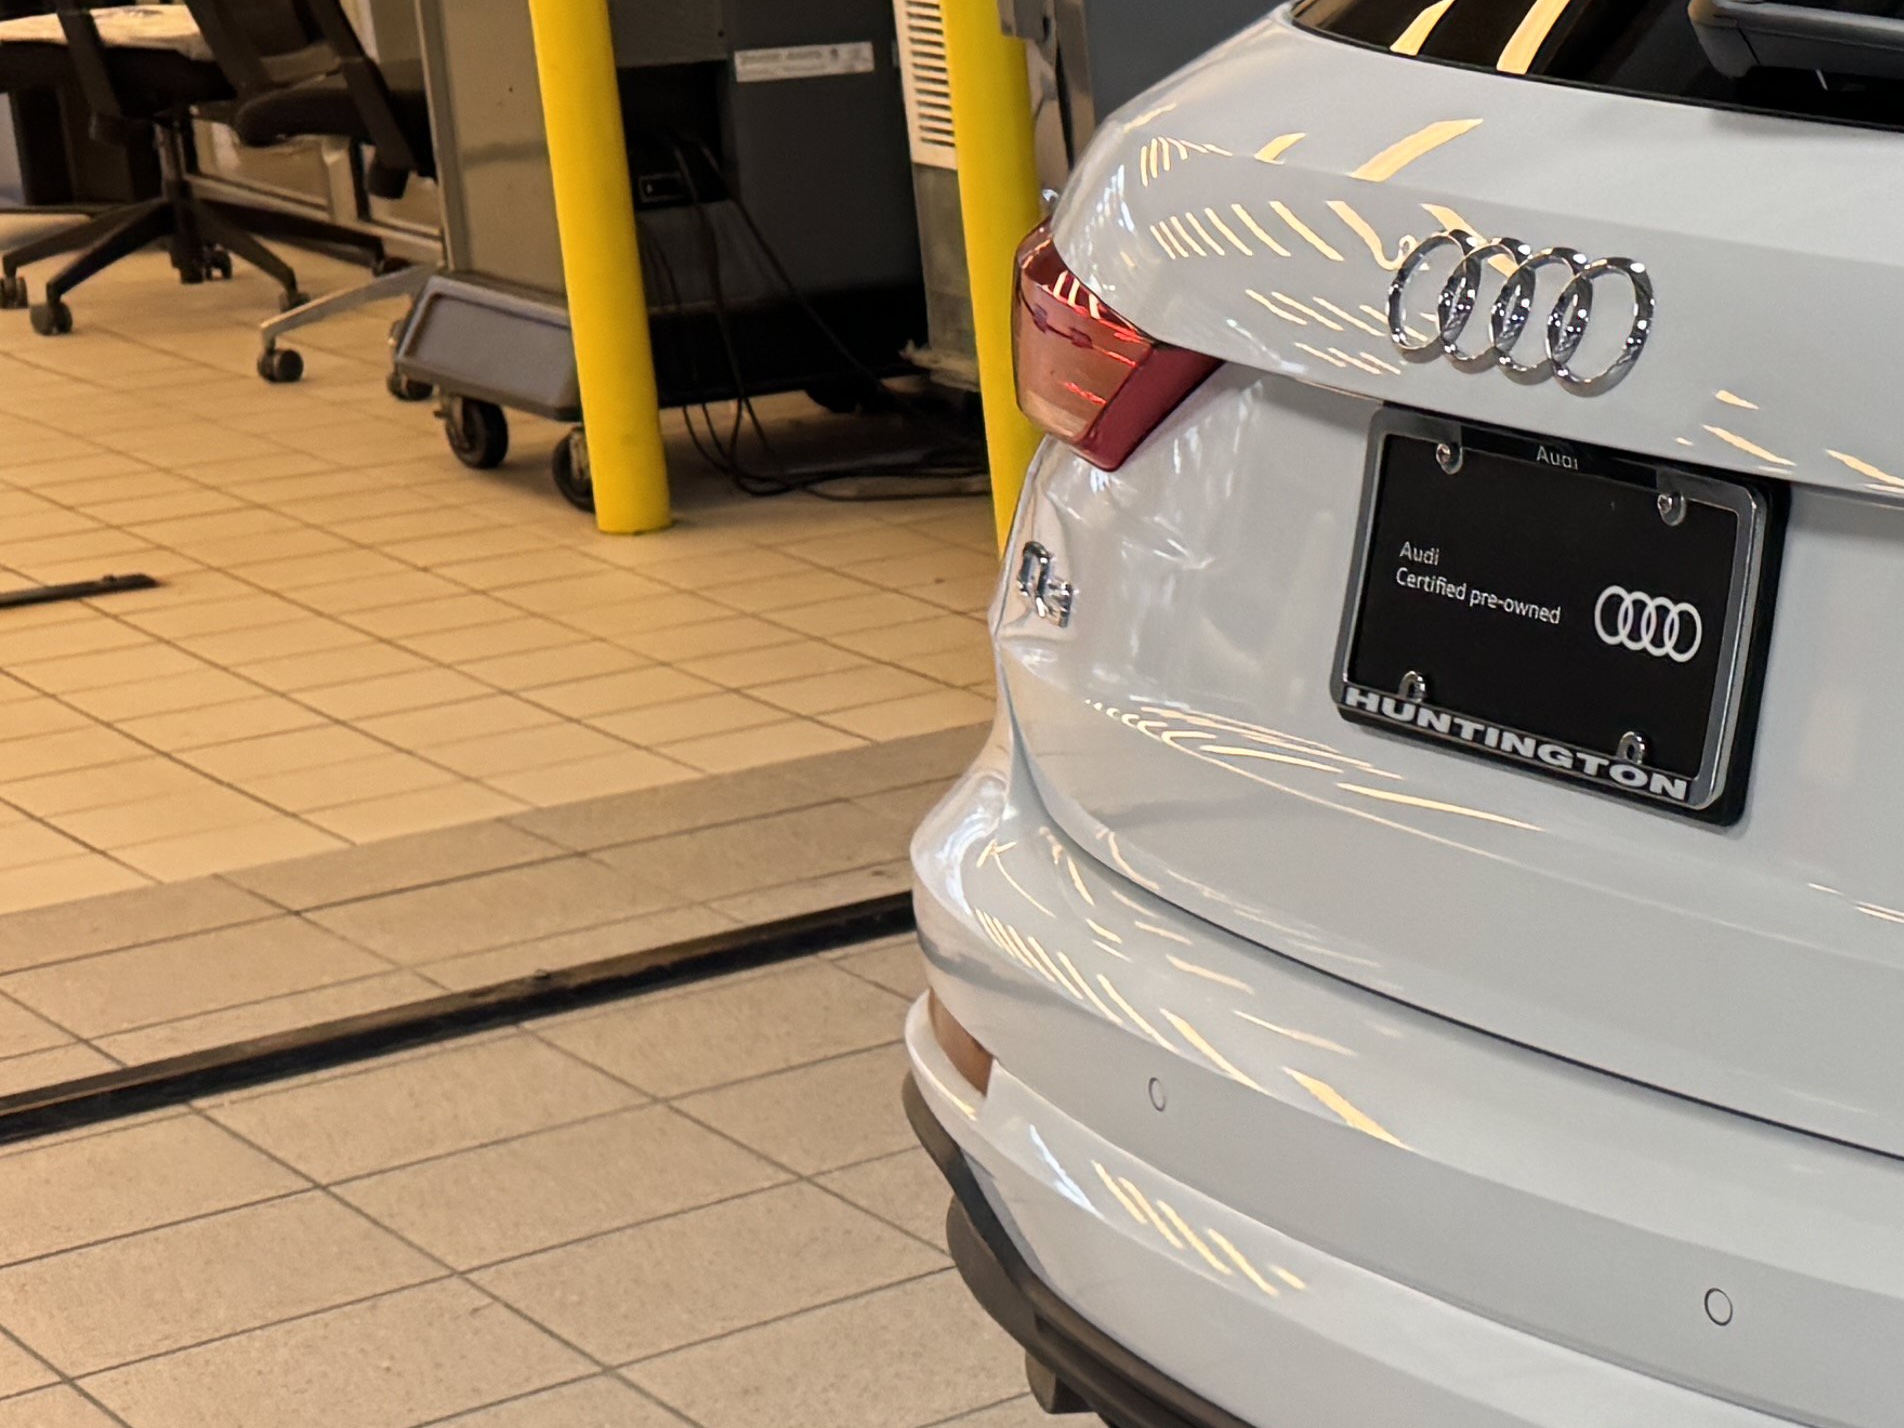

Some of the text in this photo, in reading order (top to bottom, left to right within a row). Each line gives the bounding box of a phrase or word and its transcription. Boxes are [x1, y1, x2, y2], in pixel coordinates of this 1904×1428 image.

[1399, 541, 1440, 566] Audi
[1396, 567, 1561, 625] Certified pre-owned
[1344, 686, 1688, 801] HUNTINGTON
